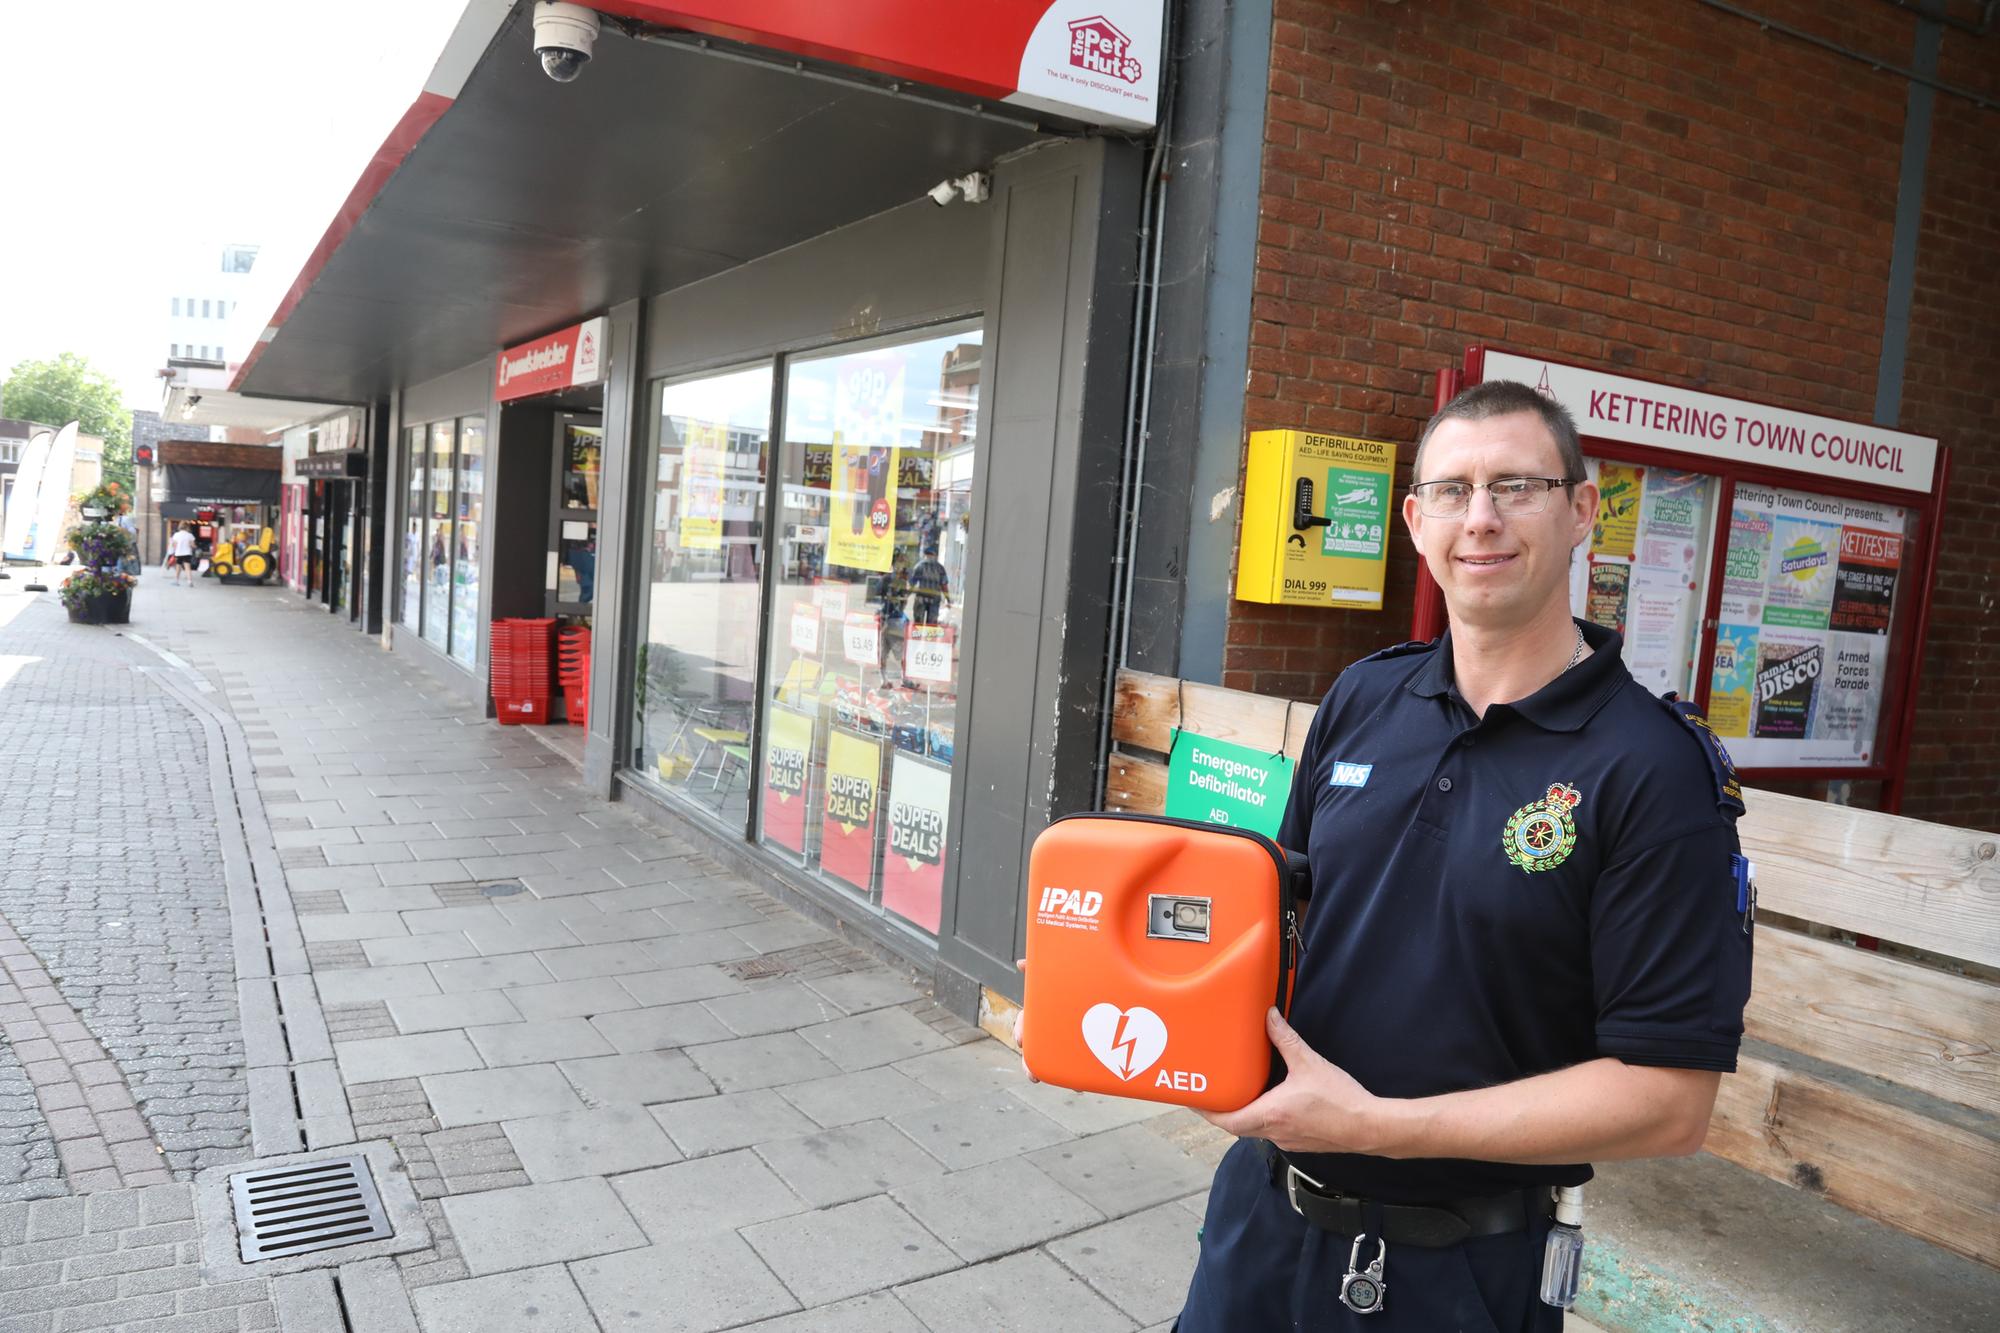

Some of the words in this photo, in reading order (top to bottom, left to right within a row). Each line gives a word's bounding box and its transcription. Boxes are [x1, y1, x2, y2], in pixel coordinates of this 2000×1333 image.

[1084, 27, 1123, 57] Pet
[1082, 47, 1122, 78] Hut
[1047, 69, 1058, 78] The
[1076, 77, 1088, 88] only
[1090, 80, 1122, 95] DISCOUNT
[1123, 91, 1133, 101] pet
[852, 367, 886, 399] 99p
[1588, 389, 1727, 441] KETTERING
[1734, 416, 1806, 455] TOWN
[1810, 432, 1905, 473] COUNCIL
[1299, 447, 1312, 455] AED
[1317, 450, 1329, 458] LIFE
[1332, 451, 1354, 460] SAVING
[1354, 454, 1389, 464] EQUIPMENT
[1305, 435, 1384, 455] DEFIBRILLATOR
[1734, 488, 1774, 508] ettering
[1776, 493, 1803, 509] Town
[1804, 498, 1844, 516] Council
[1844, 505, 1890, 524] presents...
[872, 512, 888, 528] 99p
[1841, 530, 1888, 558] KETTFEST
[1782, 552, 1828, 572] Saturdays
[1284, 578, 1306, 590] DIAL
[1309, 581, 1327, 591] 999
[1715, 656, 1734, 669] SEA
[1758, 660, 1790, 682] FRIDAY
[1792, 648, 1819, 667] NIGHT
[1838, 651, 1870, 663] Armed
[1760, 658, 1820, 702] DISCO
[1837, 664, 1869, 676] Forces
[1834, 678, 1870, 690] Parade
[770, 748, 803, 769] SUPER
[1192, 748, 1268, 787] Emergency
[768, 767, 802, 790] DEALS
[1332, 764, 1370, 784] NHS
[830, 774, 870, 800] SUPER
[1189, 770, 1266, 807] Defibrillator
[828, 798, 868, 822] DEALS
[893, 804, 940, 834] SUPER
[1209, 808, 1229, 824] AED
[892, 828, 938, 858] DEALS
[1039, 887, 1103, 916] IPAD
[1154, 1069, 1208, 1093] AED
